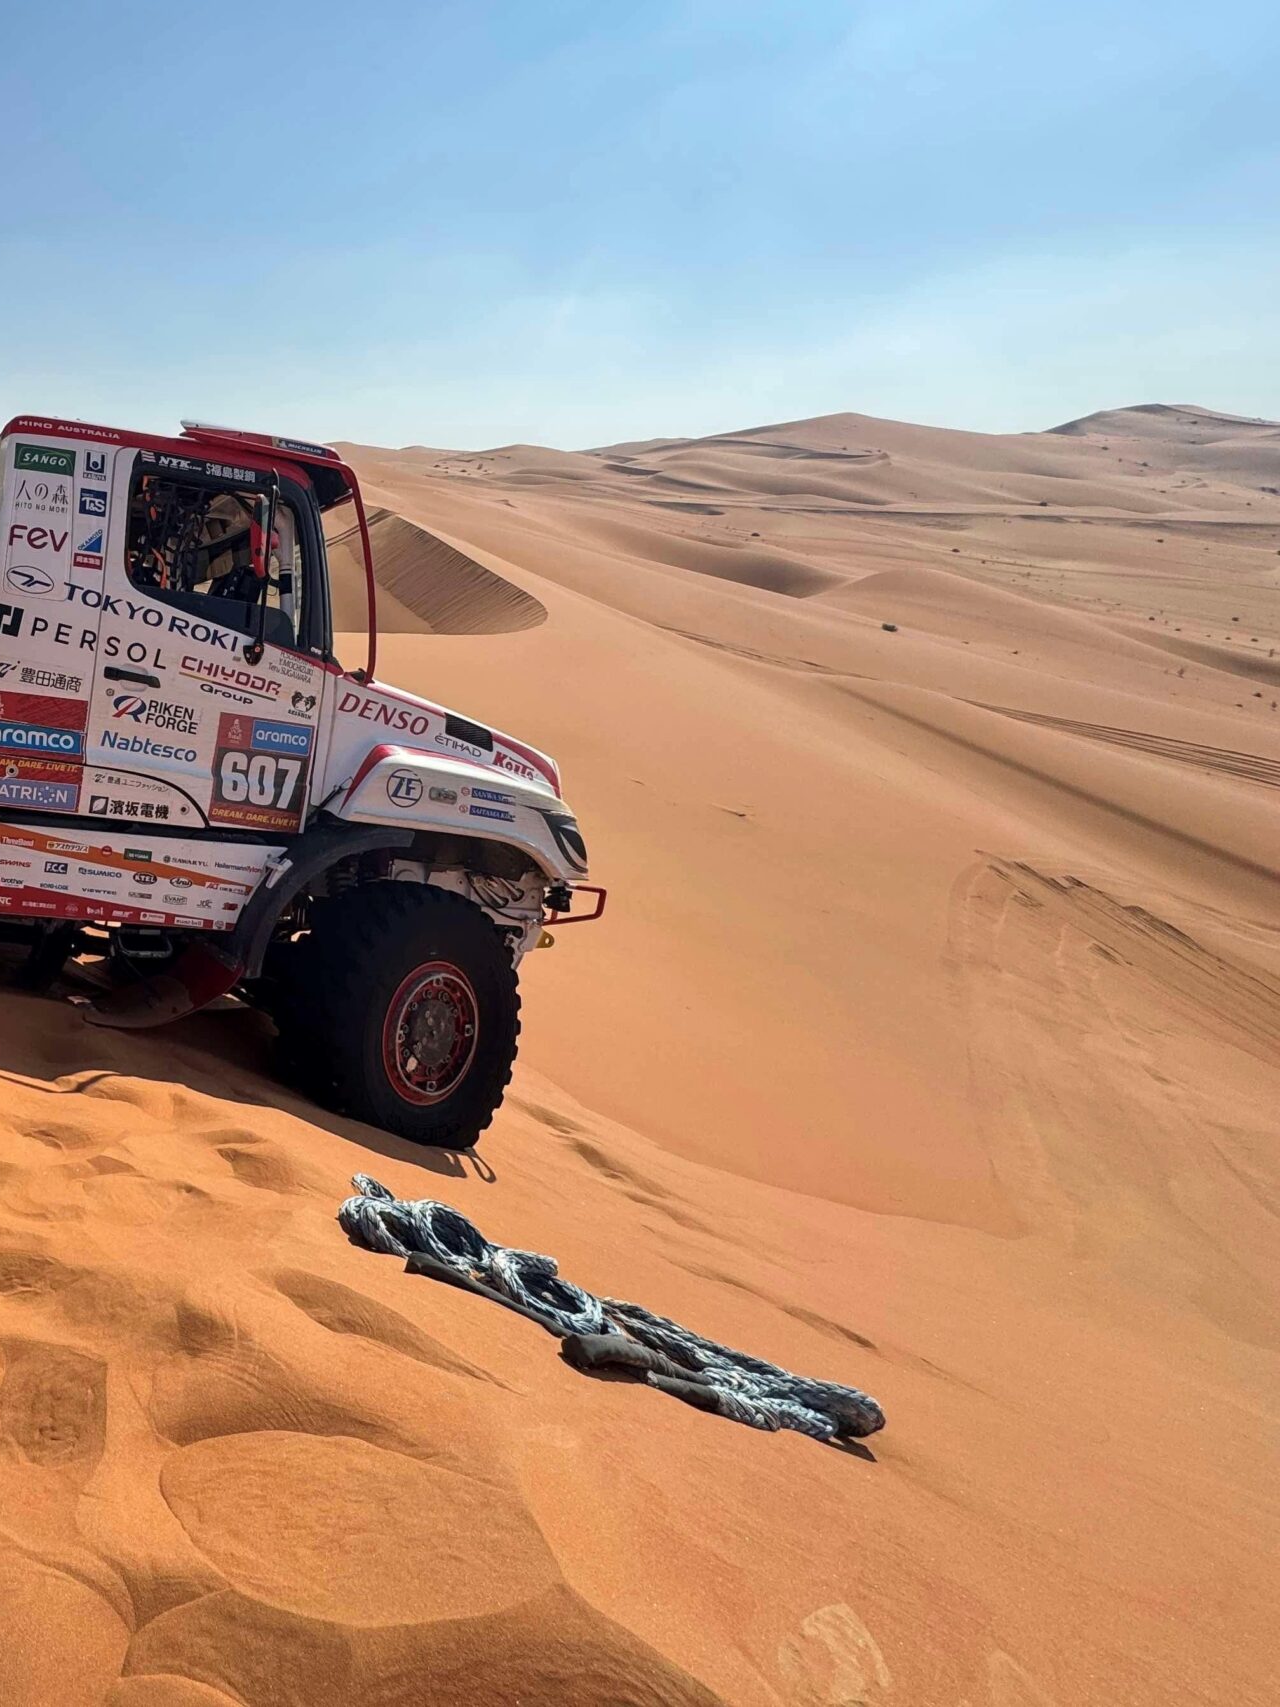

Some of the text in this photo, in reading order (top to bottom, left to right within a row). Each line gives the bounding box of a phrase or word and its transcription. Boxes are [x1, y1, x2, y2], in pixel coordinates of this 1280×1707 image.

[19, 420, 120, 439] HINO AUSTRALIA
[23, 452, 67, 466] SANGO
[159, 456, 191, 468] NYK
[16, 480, 68, 505] 人の森
[15, 502, 32, 510] HITO
[36, 503, 46, 511] NO
[81, 496, 105, 513] T&S
[64, 582, 239, 652] TOKYO ROKI
[30, 616, 167, 670] PERSOL
[19, 666, 82, 693] 豊田通商
[200, 683, 254, 705] Group
[148, 699, 194, 721] RIKEN
[337, 691, 430, 736] DENSO
[145, 713, 199, 735] FORGE
[100, 730, 198, 763] Nabtesco
[255, 729, 308, 746] aramco
[221, 751, 302, 810] 607
[391, 775, 420, 801] ZF
